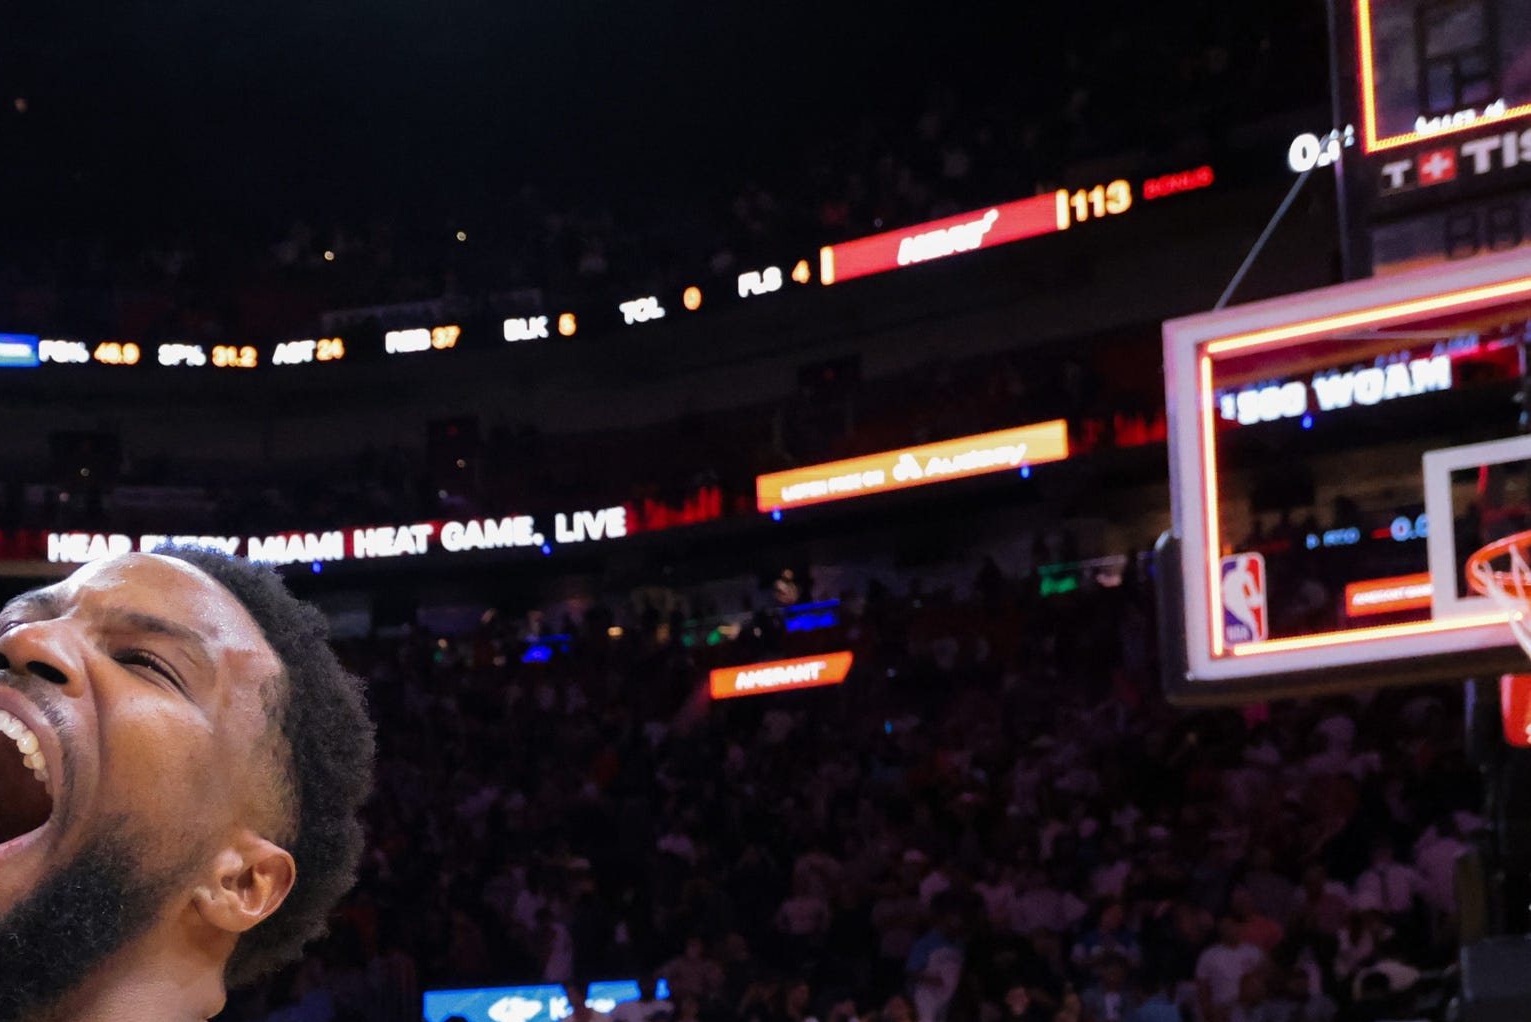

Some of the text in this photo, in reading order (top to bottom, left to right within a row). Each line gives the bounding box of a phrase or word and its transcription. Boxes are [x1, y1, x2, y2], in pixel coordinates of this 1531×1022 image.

[1070, 178, 1133, 222] 113
[504, 316, 549, 342] BLK
[792, 260, 811, 284] 4
[247, 531, 344, 567] MIAMI
[352, 523, 433, 559] HEAT
[555, 506, 627, 543] LIVE
